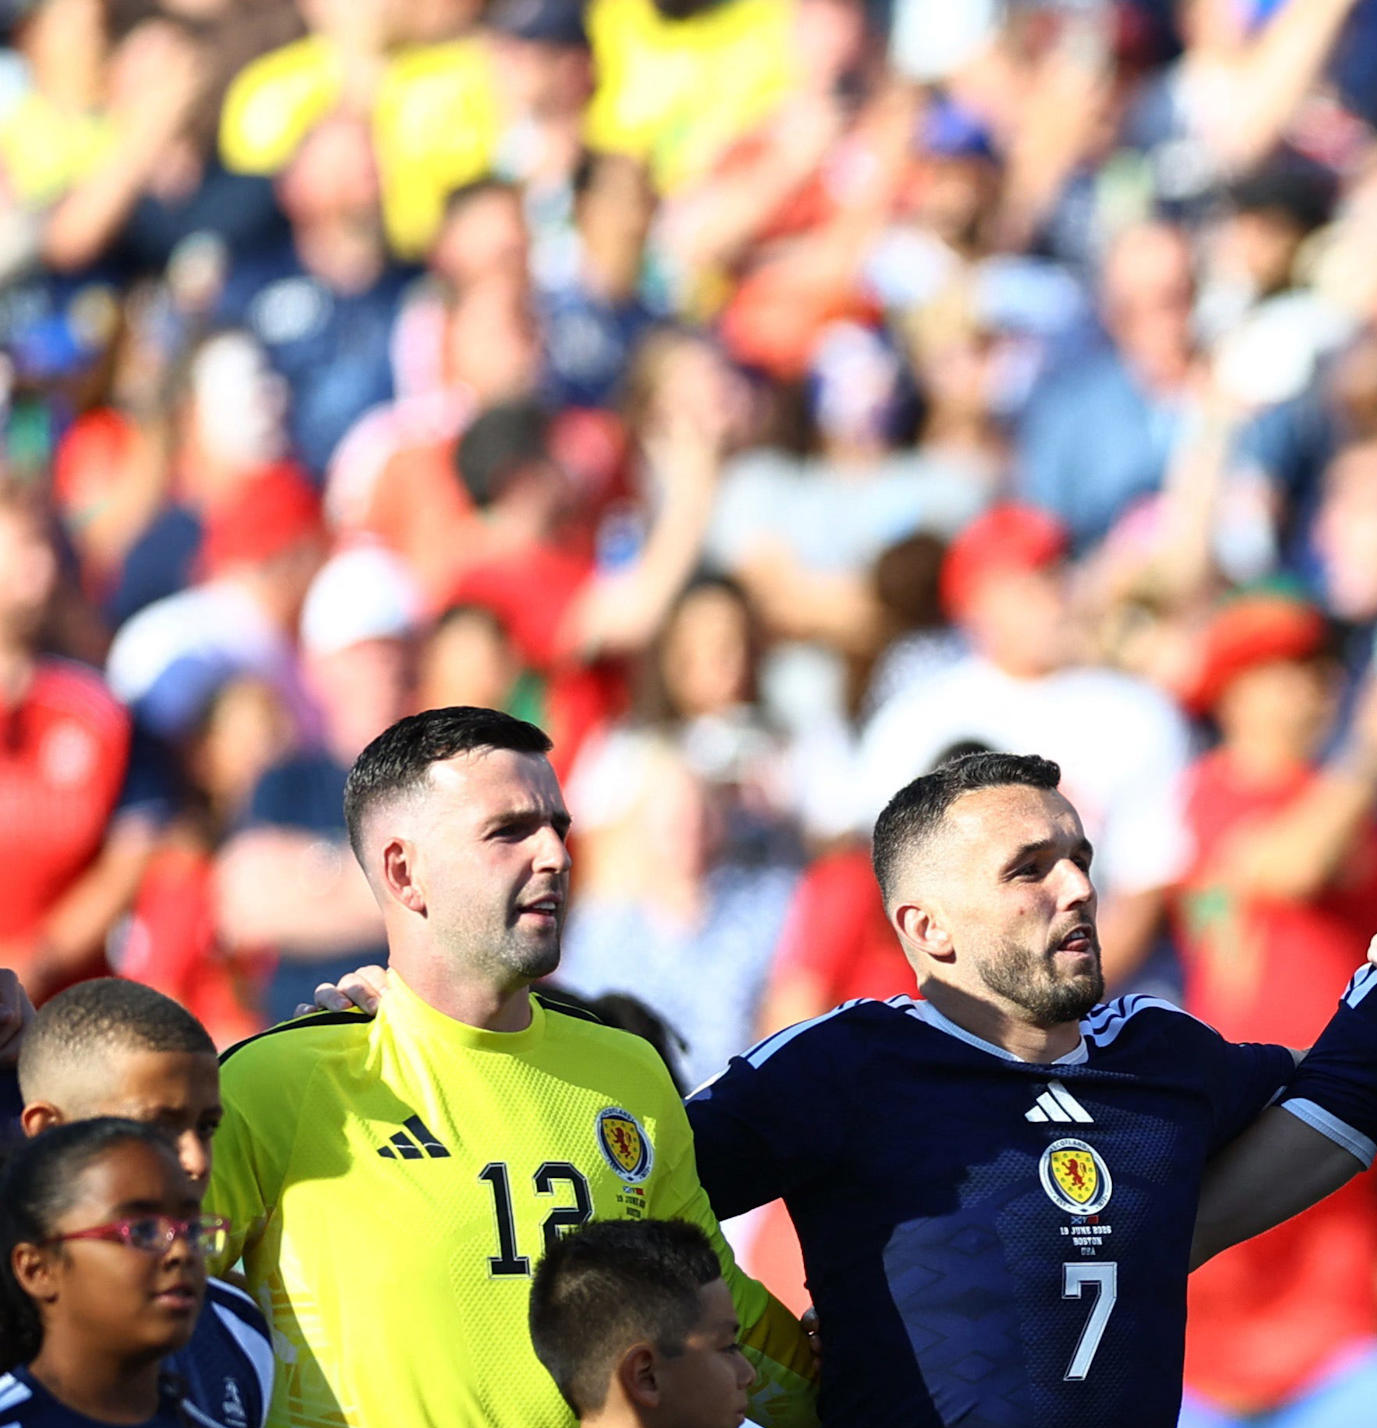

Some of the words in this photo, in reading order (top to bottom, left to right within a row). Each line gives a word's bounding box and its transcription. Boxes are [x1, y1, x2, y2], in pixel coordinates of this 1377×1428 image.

[478, 1162, 594, 1279] 12
[1072, 1236, 1103, 1246] BOSTON
[1061, 1262, 1117, 1381] 7
